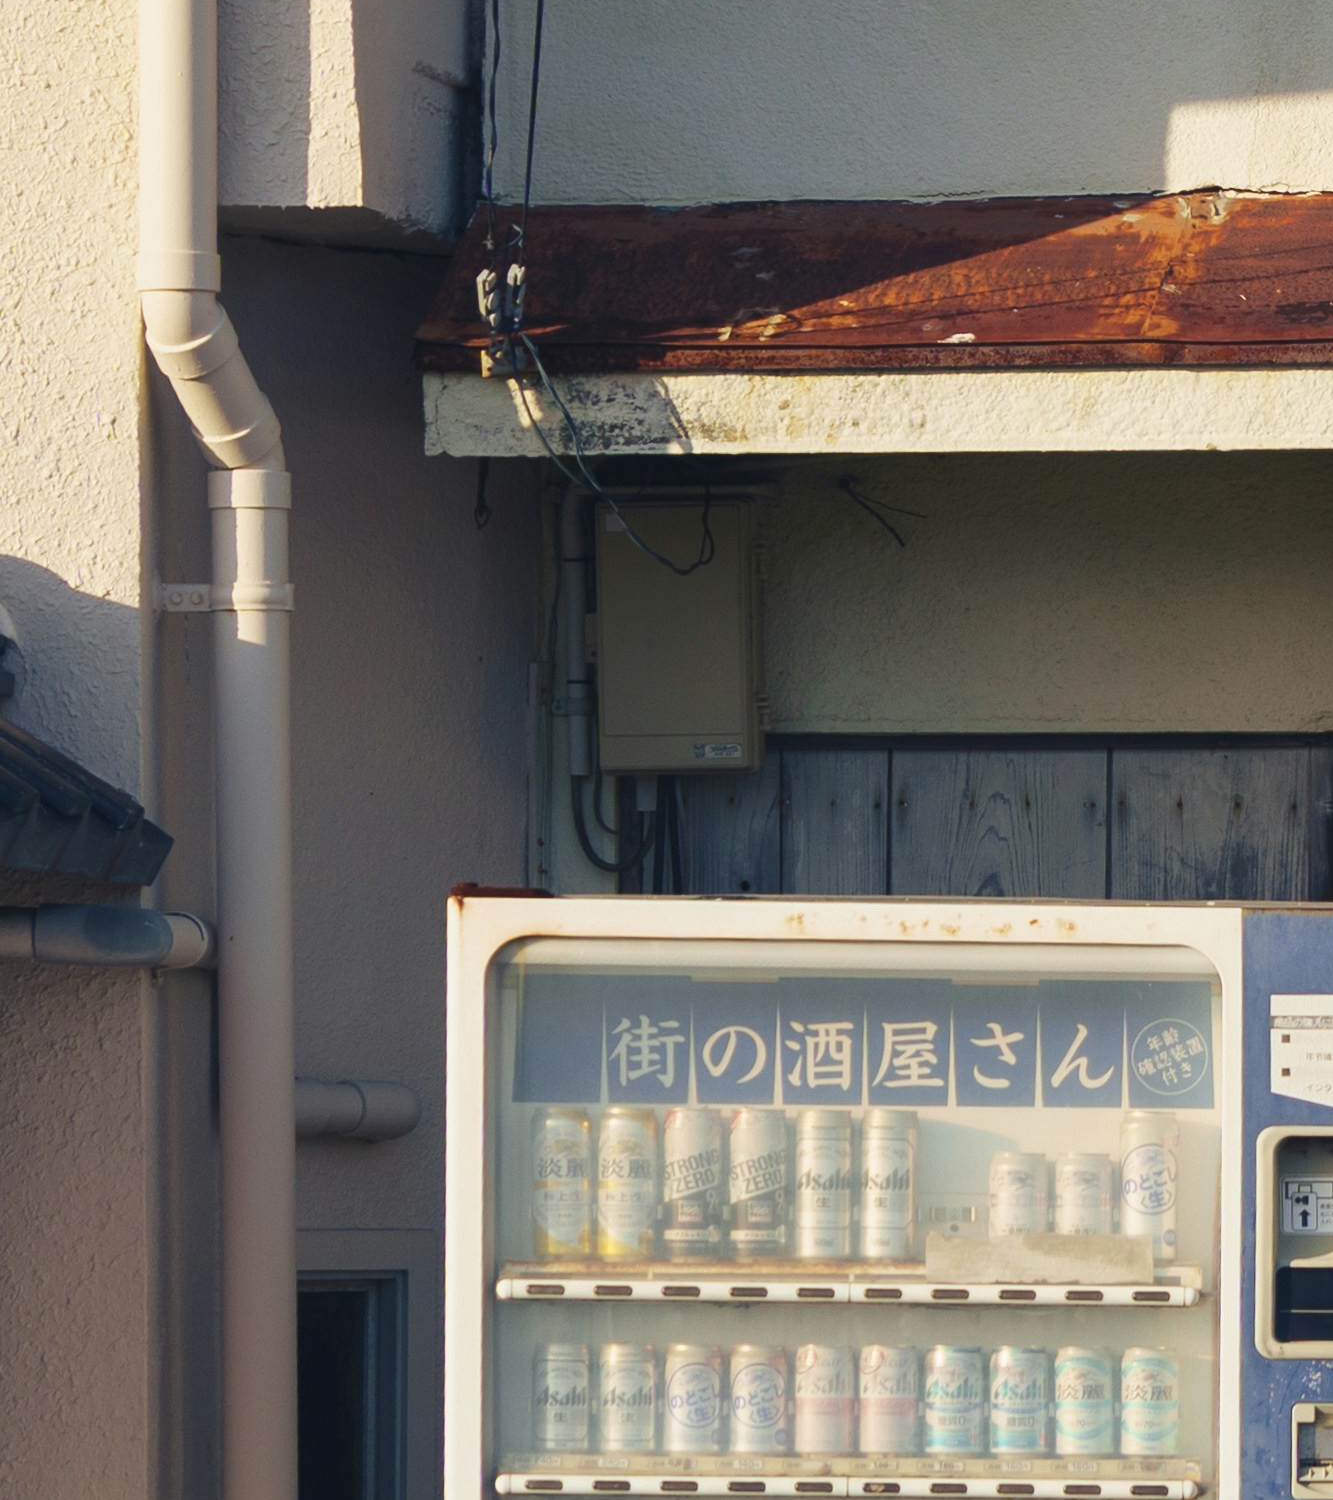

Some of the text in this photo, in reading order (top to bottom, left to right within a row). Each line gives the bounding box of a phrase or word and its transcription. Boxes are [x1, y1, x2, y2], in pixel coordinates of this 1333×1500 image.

[608, 1014, 1115, 1090] 街の酒屋さん
[664, 1148, 720, 1182] STRONG
[730, 1149, 787, 1181] STRONG
[674, 1166, 716, 1195] ZERO
[743, 1168, 784, 1195] ZERO
[536, 1385, 587, 1408] Asahi
